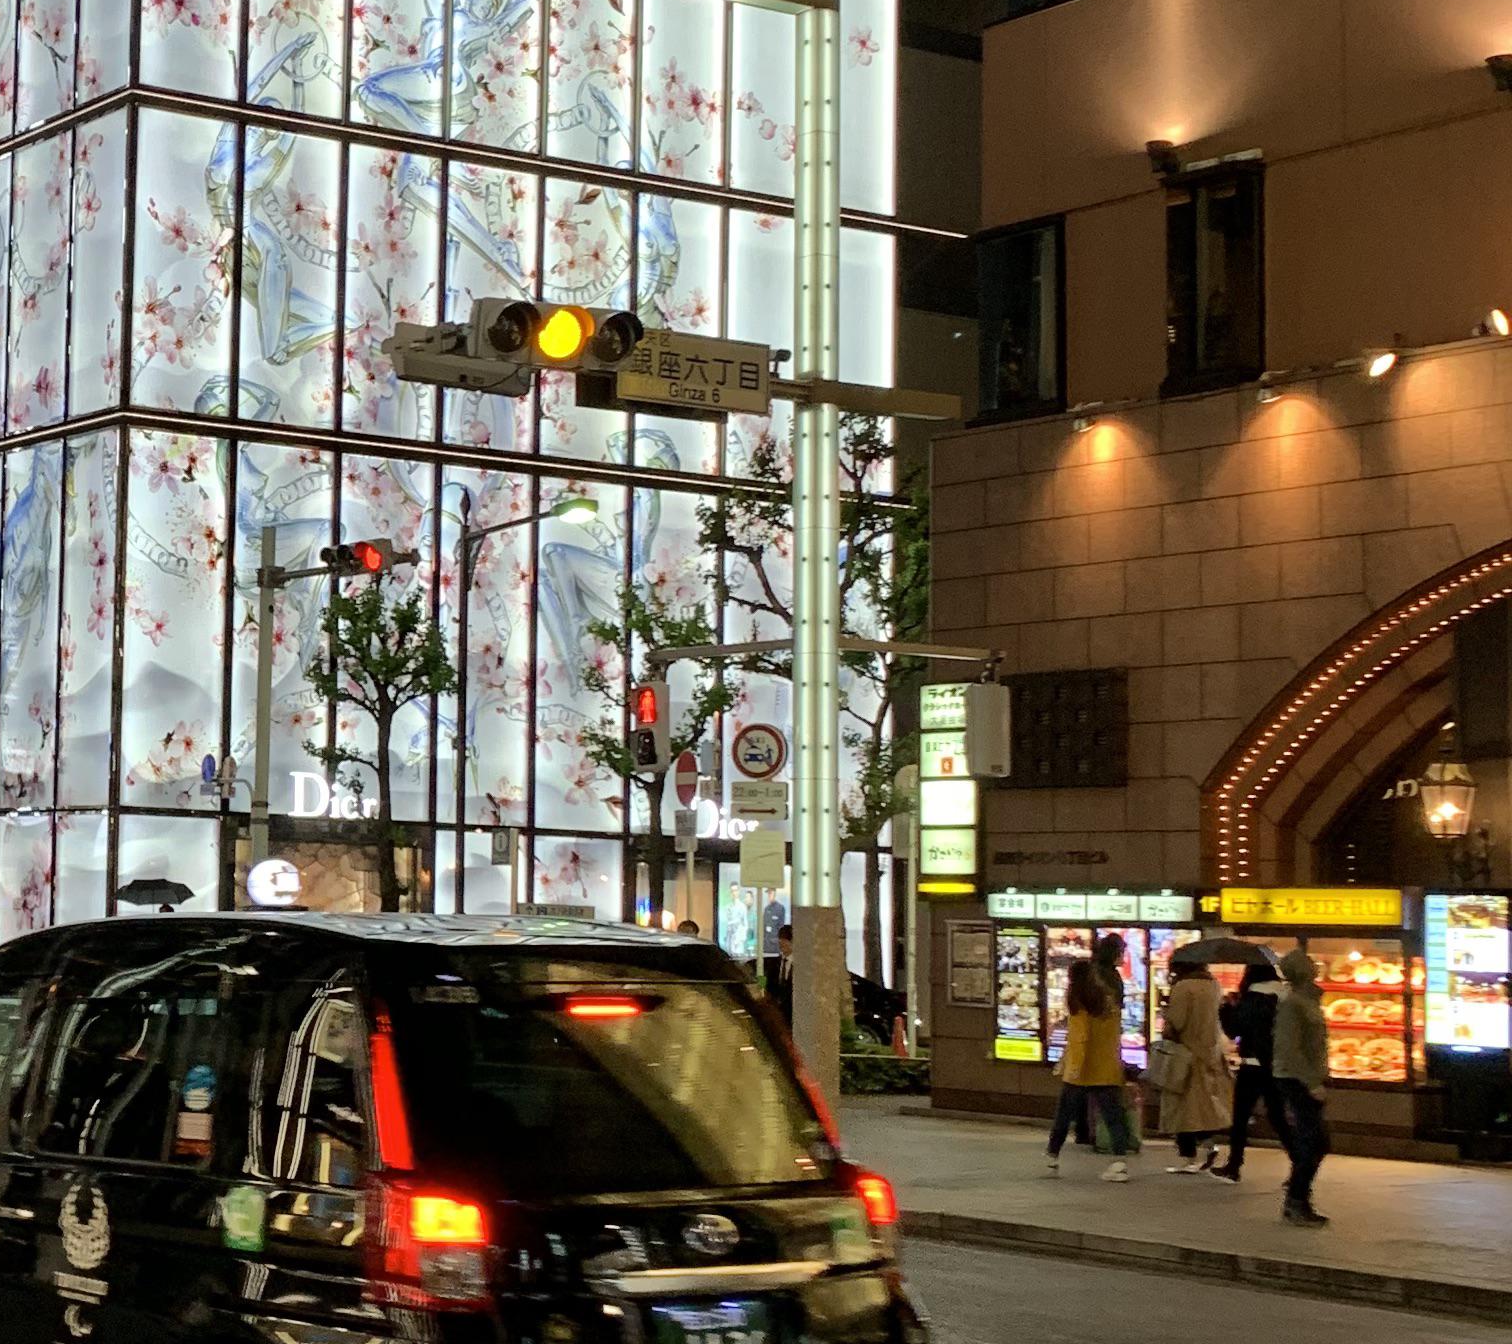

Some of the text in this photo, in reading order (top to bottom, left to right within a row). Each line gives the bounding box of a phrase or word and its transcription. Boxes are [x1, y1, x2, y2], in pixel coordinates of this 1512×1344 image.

[631, 347, 760, 390] 銀座六丁目
[669, 382, 721, 404] Ginza 6
[288, 771, 380, 820] Dior
[1199, 895, 1220, 913] 1F
